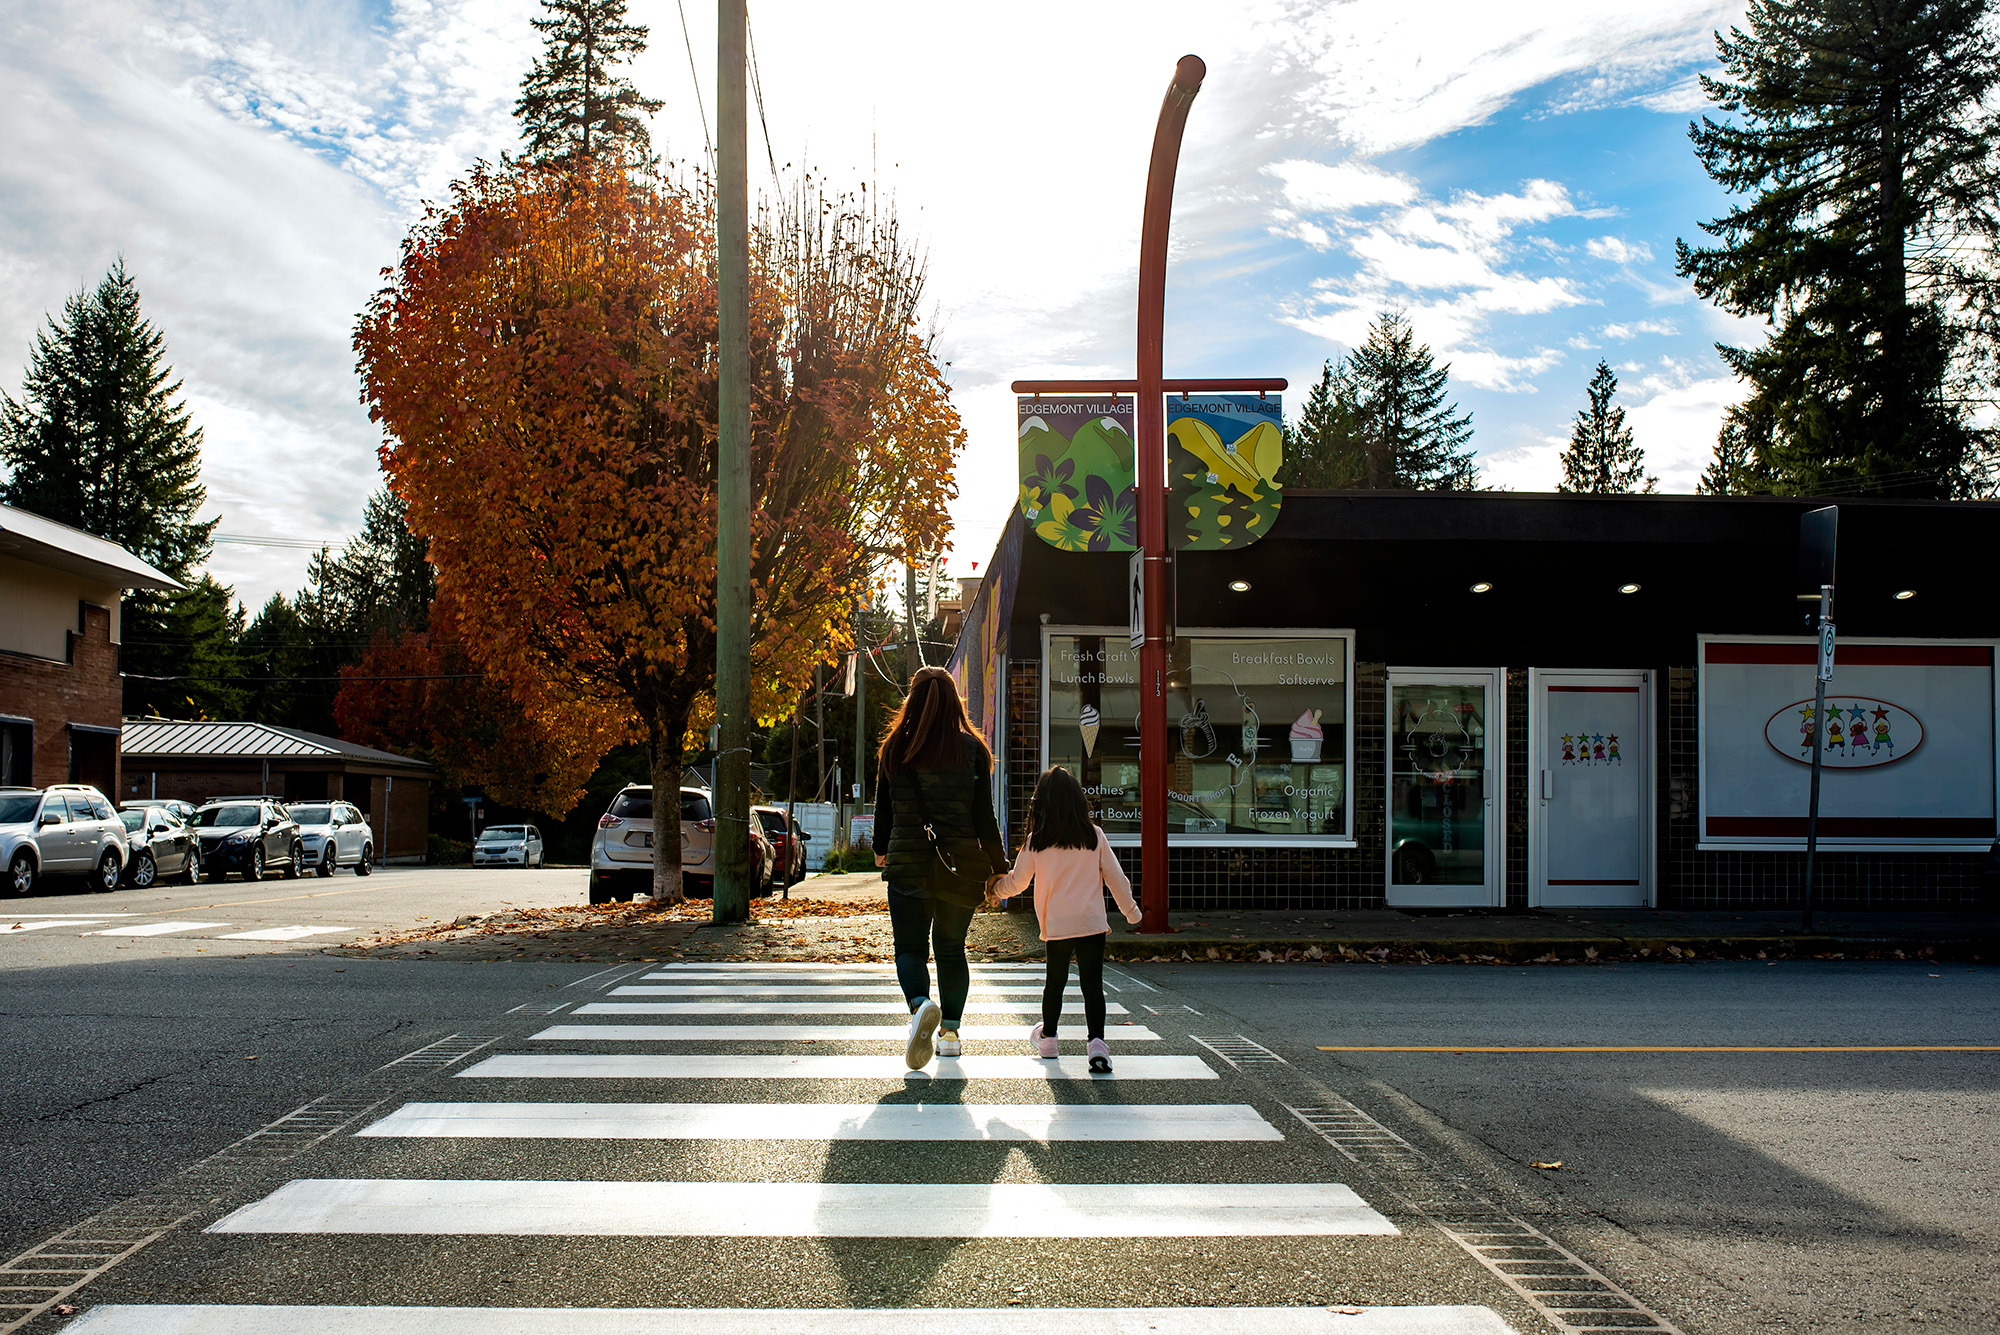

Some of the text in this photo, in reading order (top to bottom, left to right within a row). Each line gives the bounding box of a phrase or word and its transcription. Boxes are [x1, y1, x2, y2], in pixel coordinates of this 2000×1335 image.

[1019, 404, 1132, 414] EDGEMONT VILLAGE
[1168, 404, 1280, 413] EDGEMONT VILLAGE
[1061, 650, 1093, 661] Fresh
[1096, 650, 1127, 662] Craft
[1232, 652, 1335, 665] Breakfast Bowls
[1060, 672, 1134, 684] Lunch Bowls
[1278, 674, 1335, 685] Softserve
[1167, 788, 1226, 802] YOGURT SHOP
[1284, 785, 1334, 799] Organic
[1107, 807, 1142, 819] Bowls
[1248, 808, 1334, 822] Frozen Yogurt
[1442, 783, 1453, 854] CLOSED
